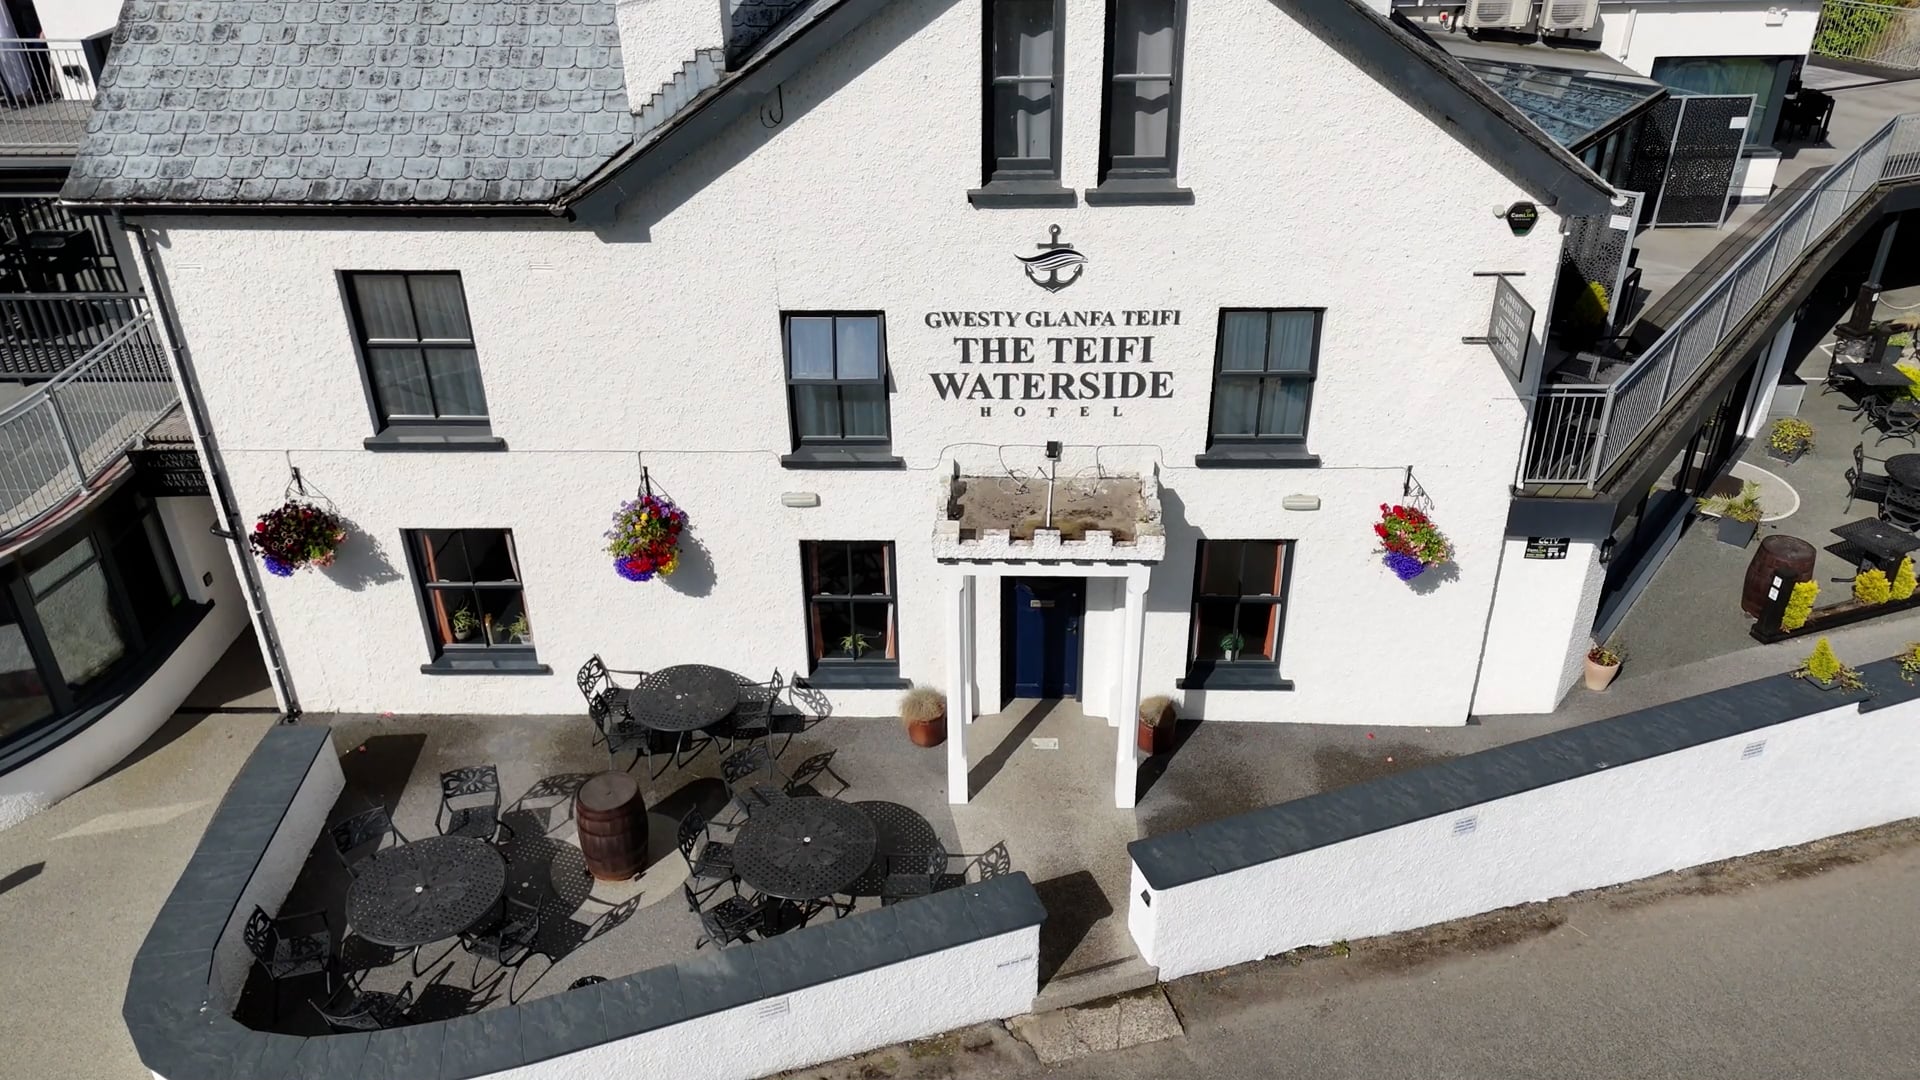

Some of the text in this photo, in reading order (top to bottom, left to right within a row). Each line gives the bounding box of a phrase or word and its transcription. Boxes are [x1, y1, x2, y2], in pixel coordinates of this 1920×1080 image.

[924, 309, 1181, 328] GWESTY GLANFA TEIFI
[953, 336, 1155, 364] THE TEIFI
[929, 371, 1174, 400] WATERSIDE
[980, 406, 1123, 417] HOTEL
